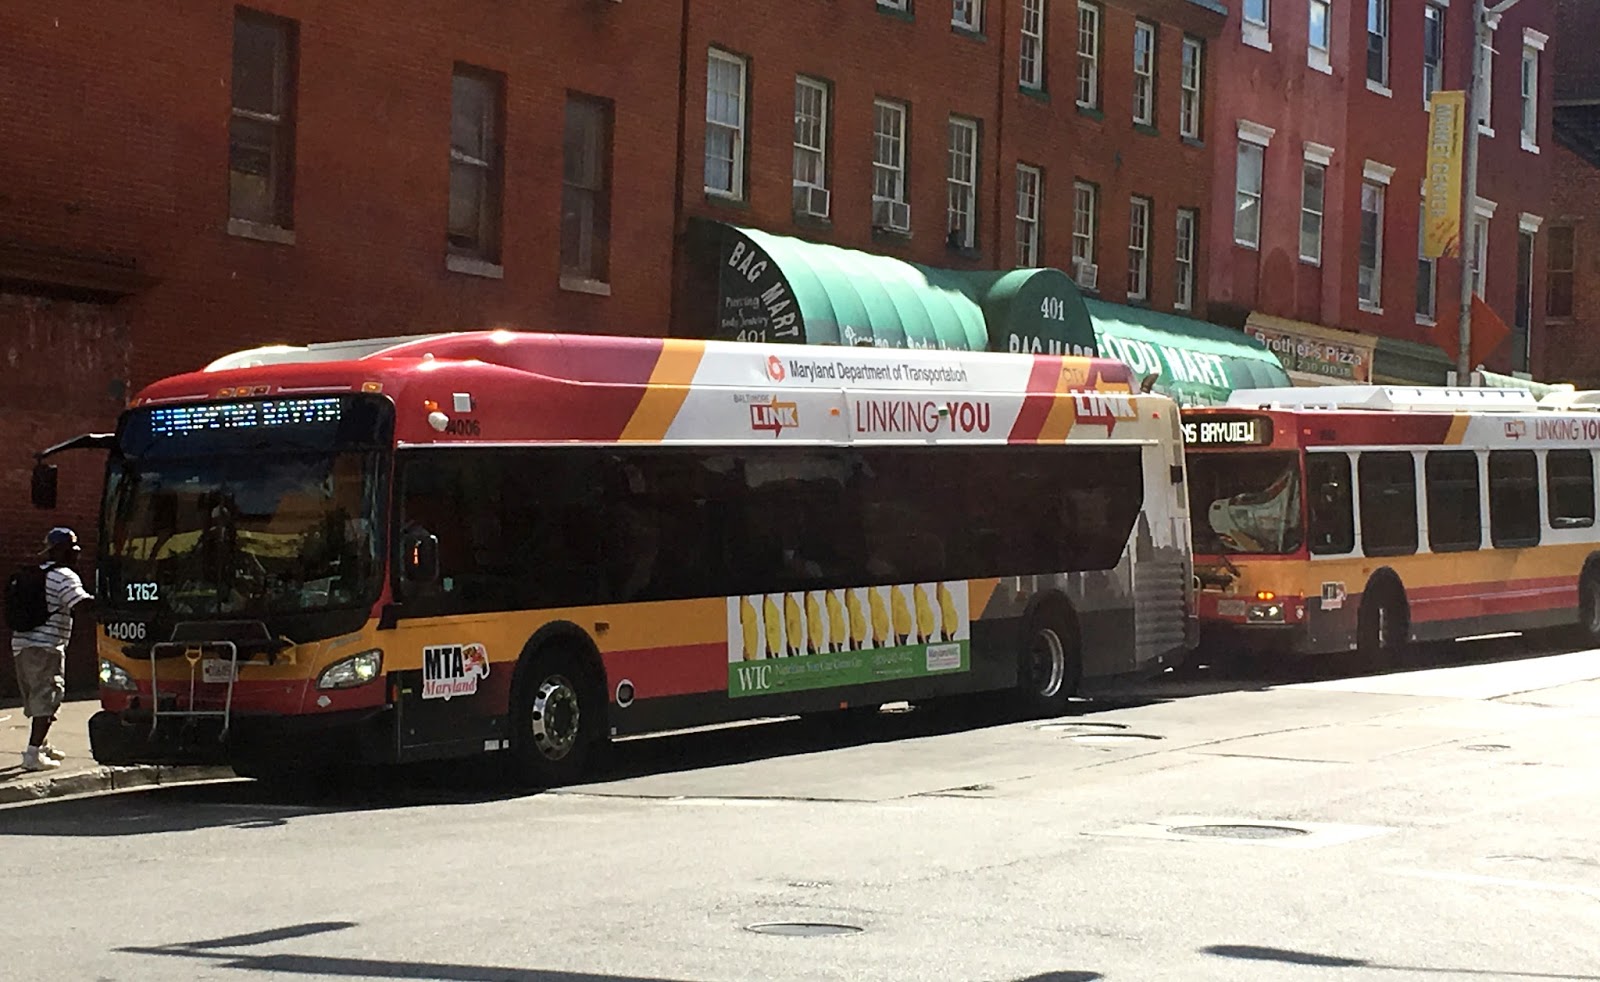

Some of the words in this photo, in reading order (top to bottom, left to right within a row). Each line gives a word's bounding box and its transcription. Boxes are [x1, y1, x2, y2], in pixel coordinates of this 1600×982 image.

[728, 241, 768, 283] BAG
[760, 281, 799, 337] MART
[1040, 296, 1065, 321] 401
[736, 329, 766, 343] 401
[1159, 344, 1230, 388] MART
[1325, 345, 1362, 366] Pizza
[789, 360, 835, 383] Maryland
[837, 362, 892, 383] Department
[893, 364, 902, 381] of
[902, 364, 968, 386] Transportation
[1069, 389, 1138, 418] LINK
[751, 406, 798, 426] LINK
[856, 400, 940, 433] LINKING
[946, 402, 991, 433] YOU
[1200, 421, 1255, 442] BAYVIEW
[1535, 418, 1580, 441] LINKING
[1581, 418, 1600, 441] YO
[126, 582, 159, 601] 1762
[107, 622, 147, 640] 14006
[425, 647, 465, 680] MTA
[424, 677, 476, 698] Maryland
[737, 664, 773, 691] WIC
